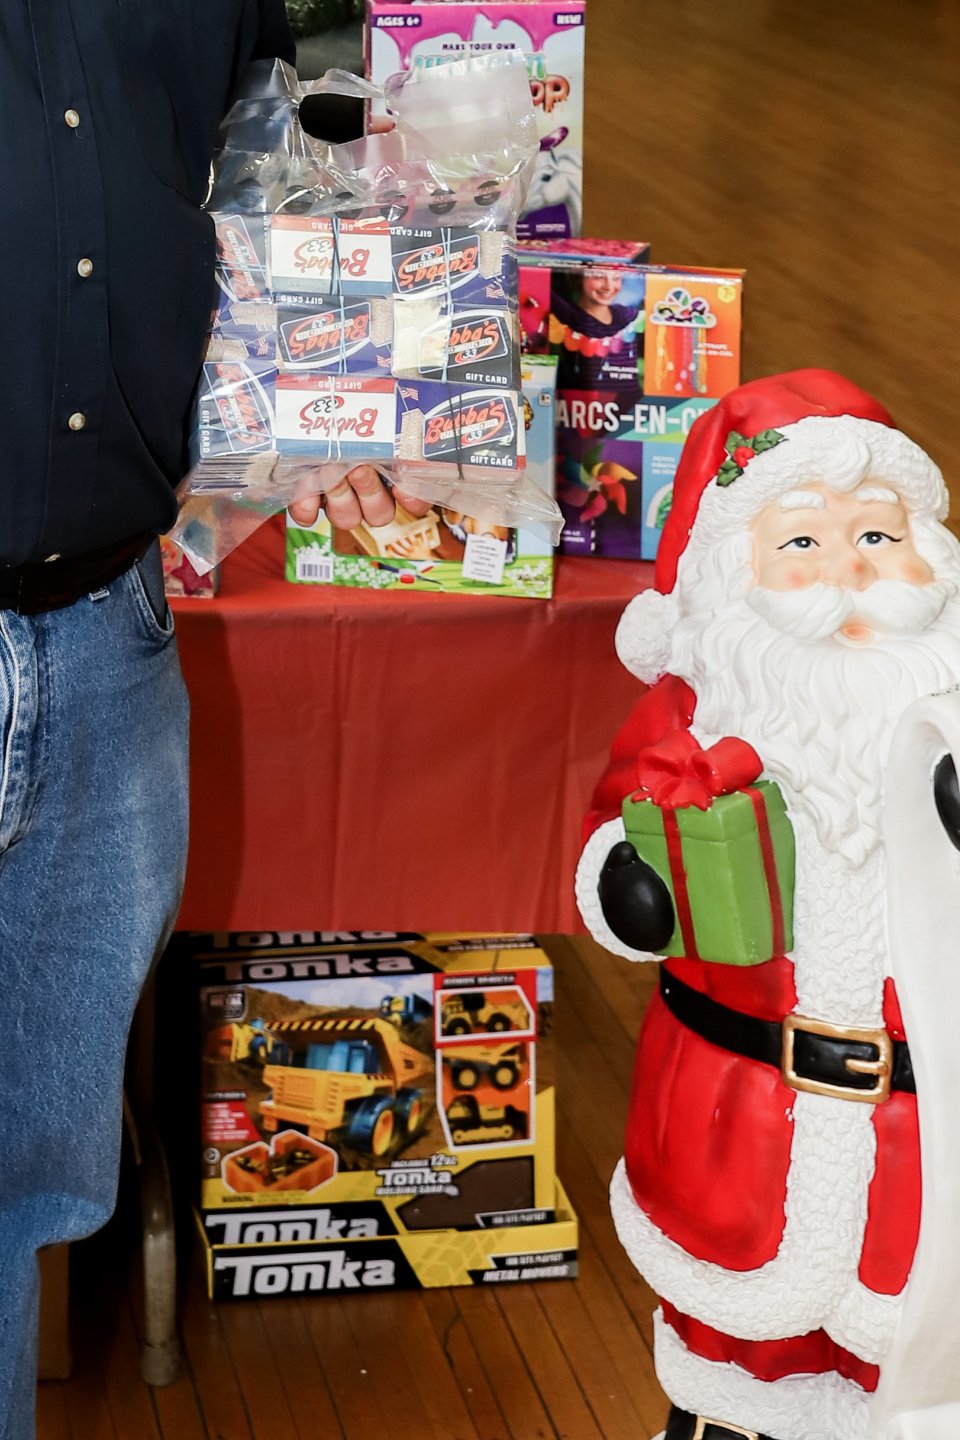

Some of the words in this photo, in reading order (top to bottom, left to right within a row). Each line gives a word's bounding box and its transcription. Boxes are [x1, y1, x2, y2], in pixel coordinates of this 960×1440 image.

[376, 16, 405, 26] AGES
[469, 43, 493, 51] YOUR
[414, 230, 432, 238] GIFT
[307, 239, 330, 252] 33
[305, 297, 323, 305] GIFT
[463, 348, 478, 359] 33
[465, 373, 484, 381] GIFT
[485, 374, 508, 385] CARD
[344, 381, 363, 390] GIFT
[313, 398, 337, 413] 33
[424, 401, 505, 446] Bubba's
[556, 399, 711, 436] ARCS-EN-C
[202, 430, 210, 453] CARD
[467, 431, 483, 441] 33
[470, 455, 488, 464] GIFT
[490, 457, 513, 467] CARD
[200, 953, 415, 981] Tonka
[377, 1167, 452, 1186] Tonka
[205, 1208, 379, 1245] Tonka
[214, 1250, 396, 1296] Tonka
